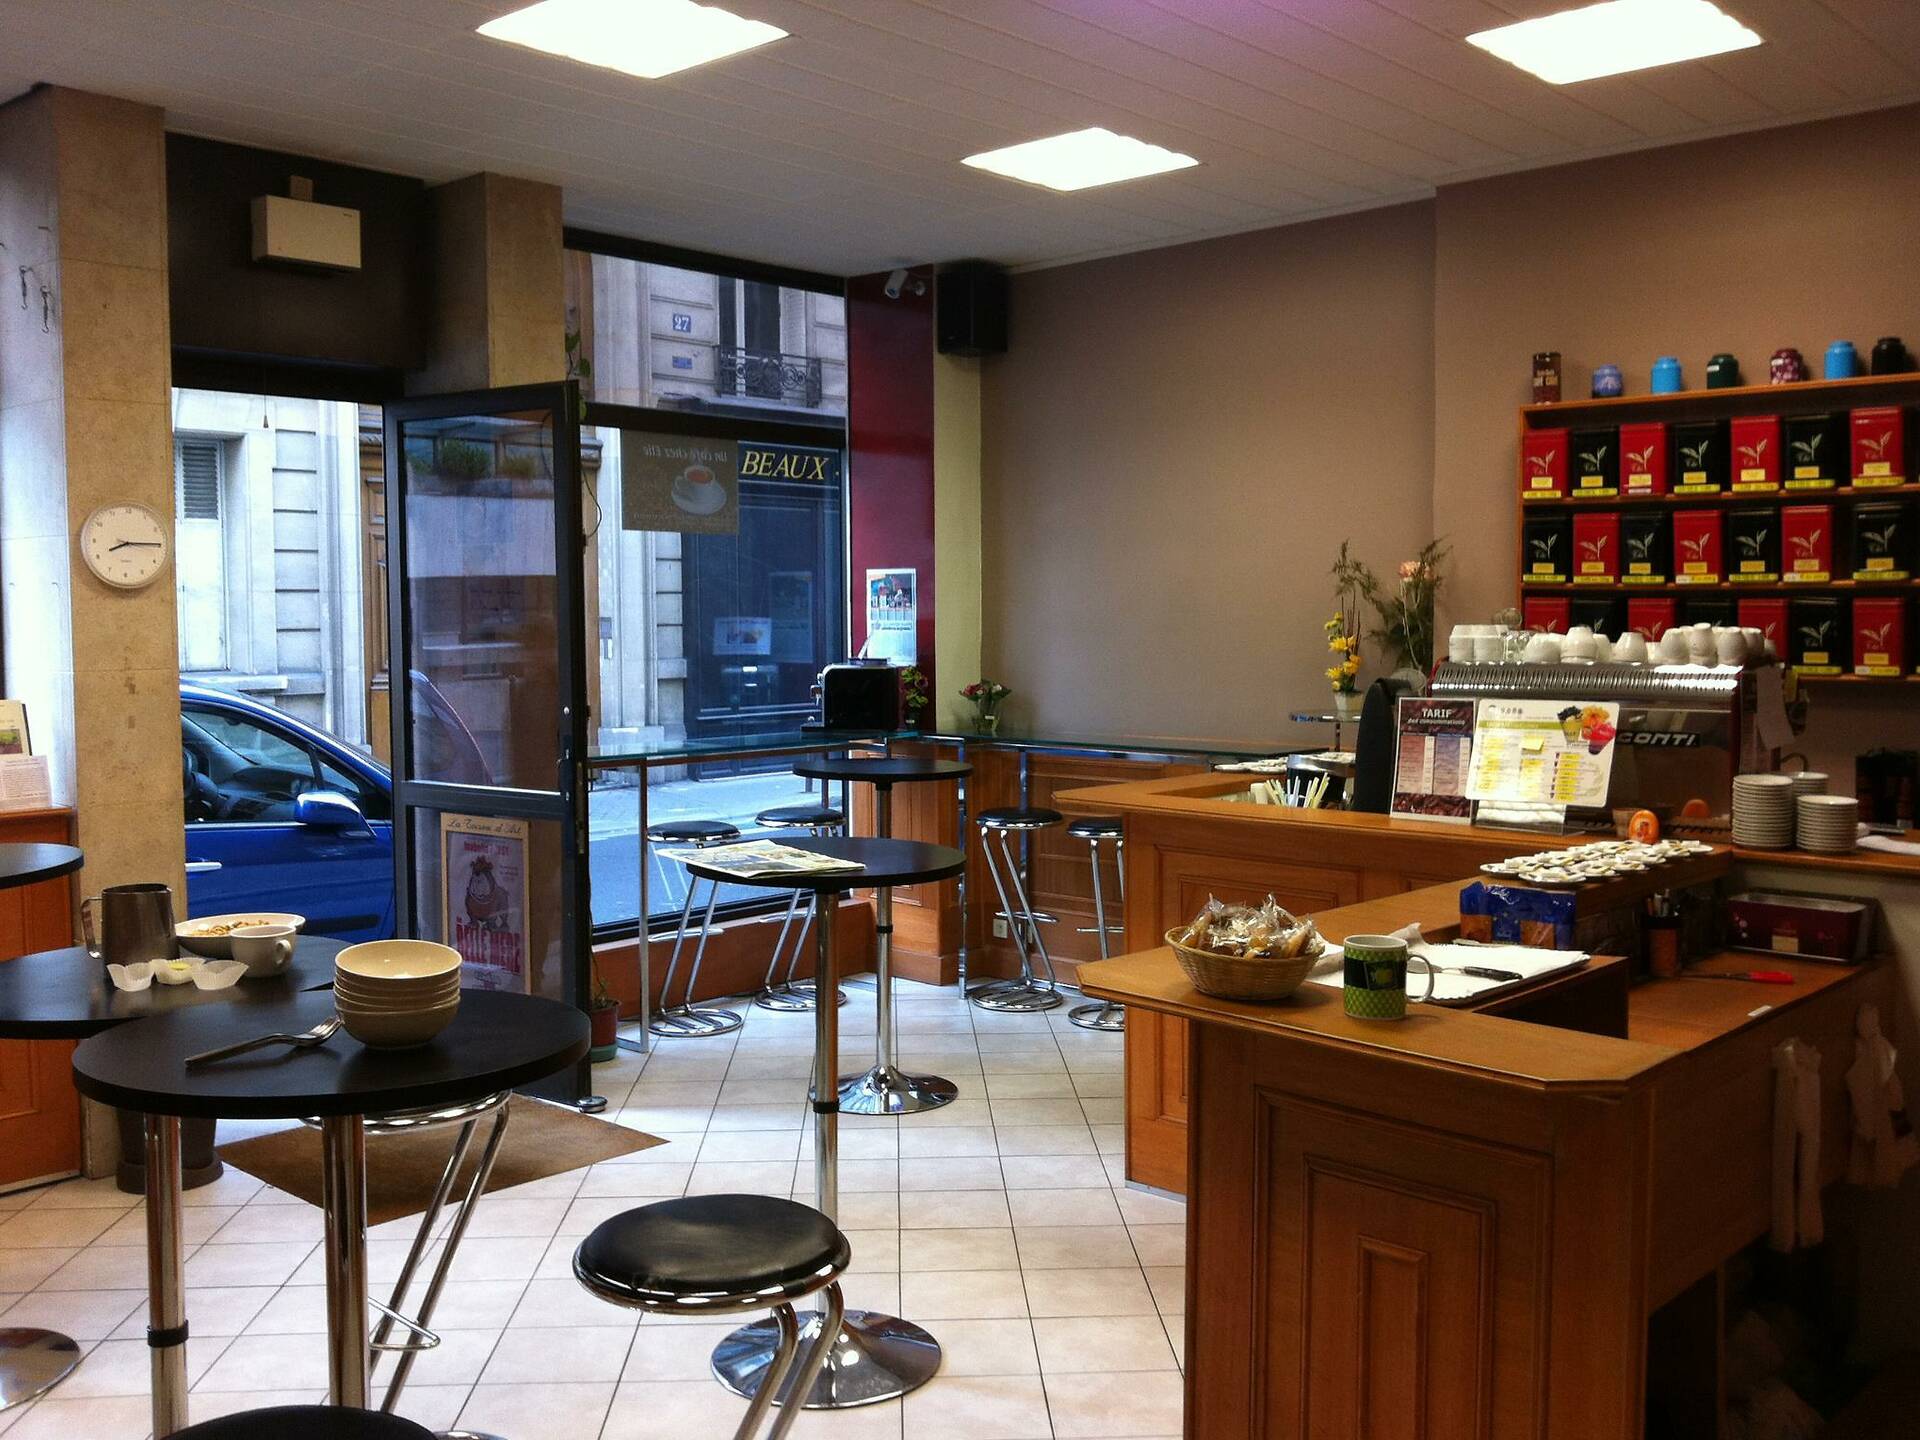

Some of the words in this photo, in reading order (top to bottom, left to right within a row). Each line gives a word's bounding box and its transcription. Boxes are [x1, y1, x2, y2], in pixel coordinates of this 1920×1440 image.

[674, 315, 690, 331] 27
[740, 450, 830, 480] BEAUX
[1421, 708, 1454, 719] TARIF
